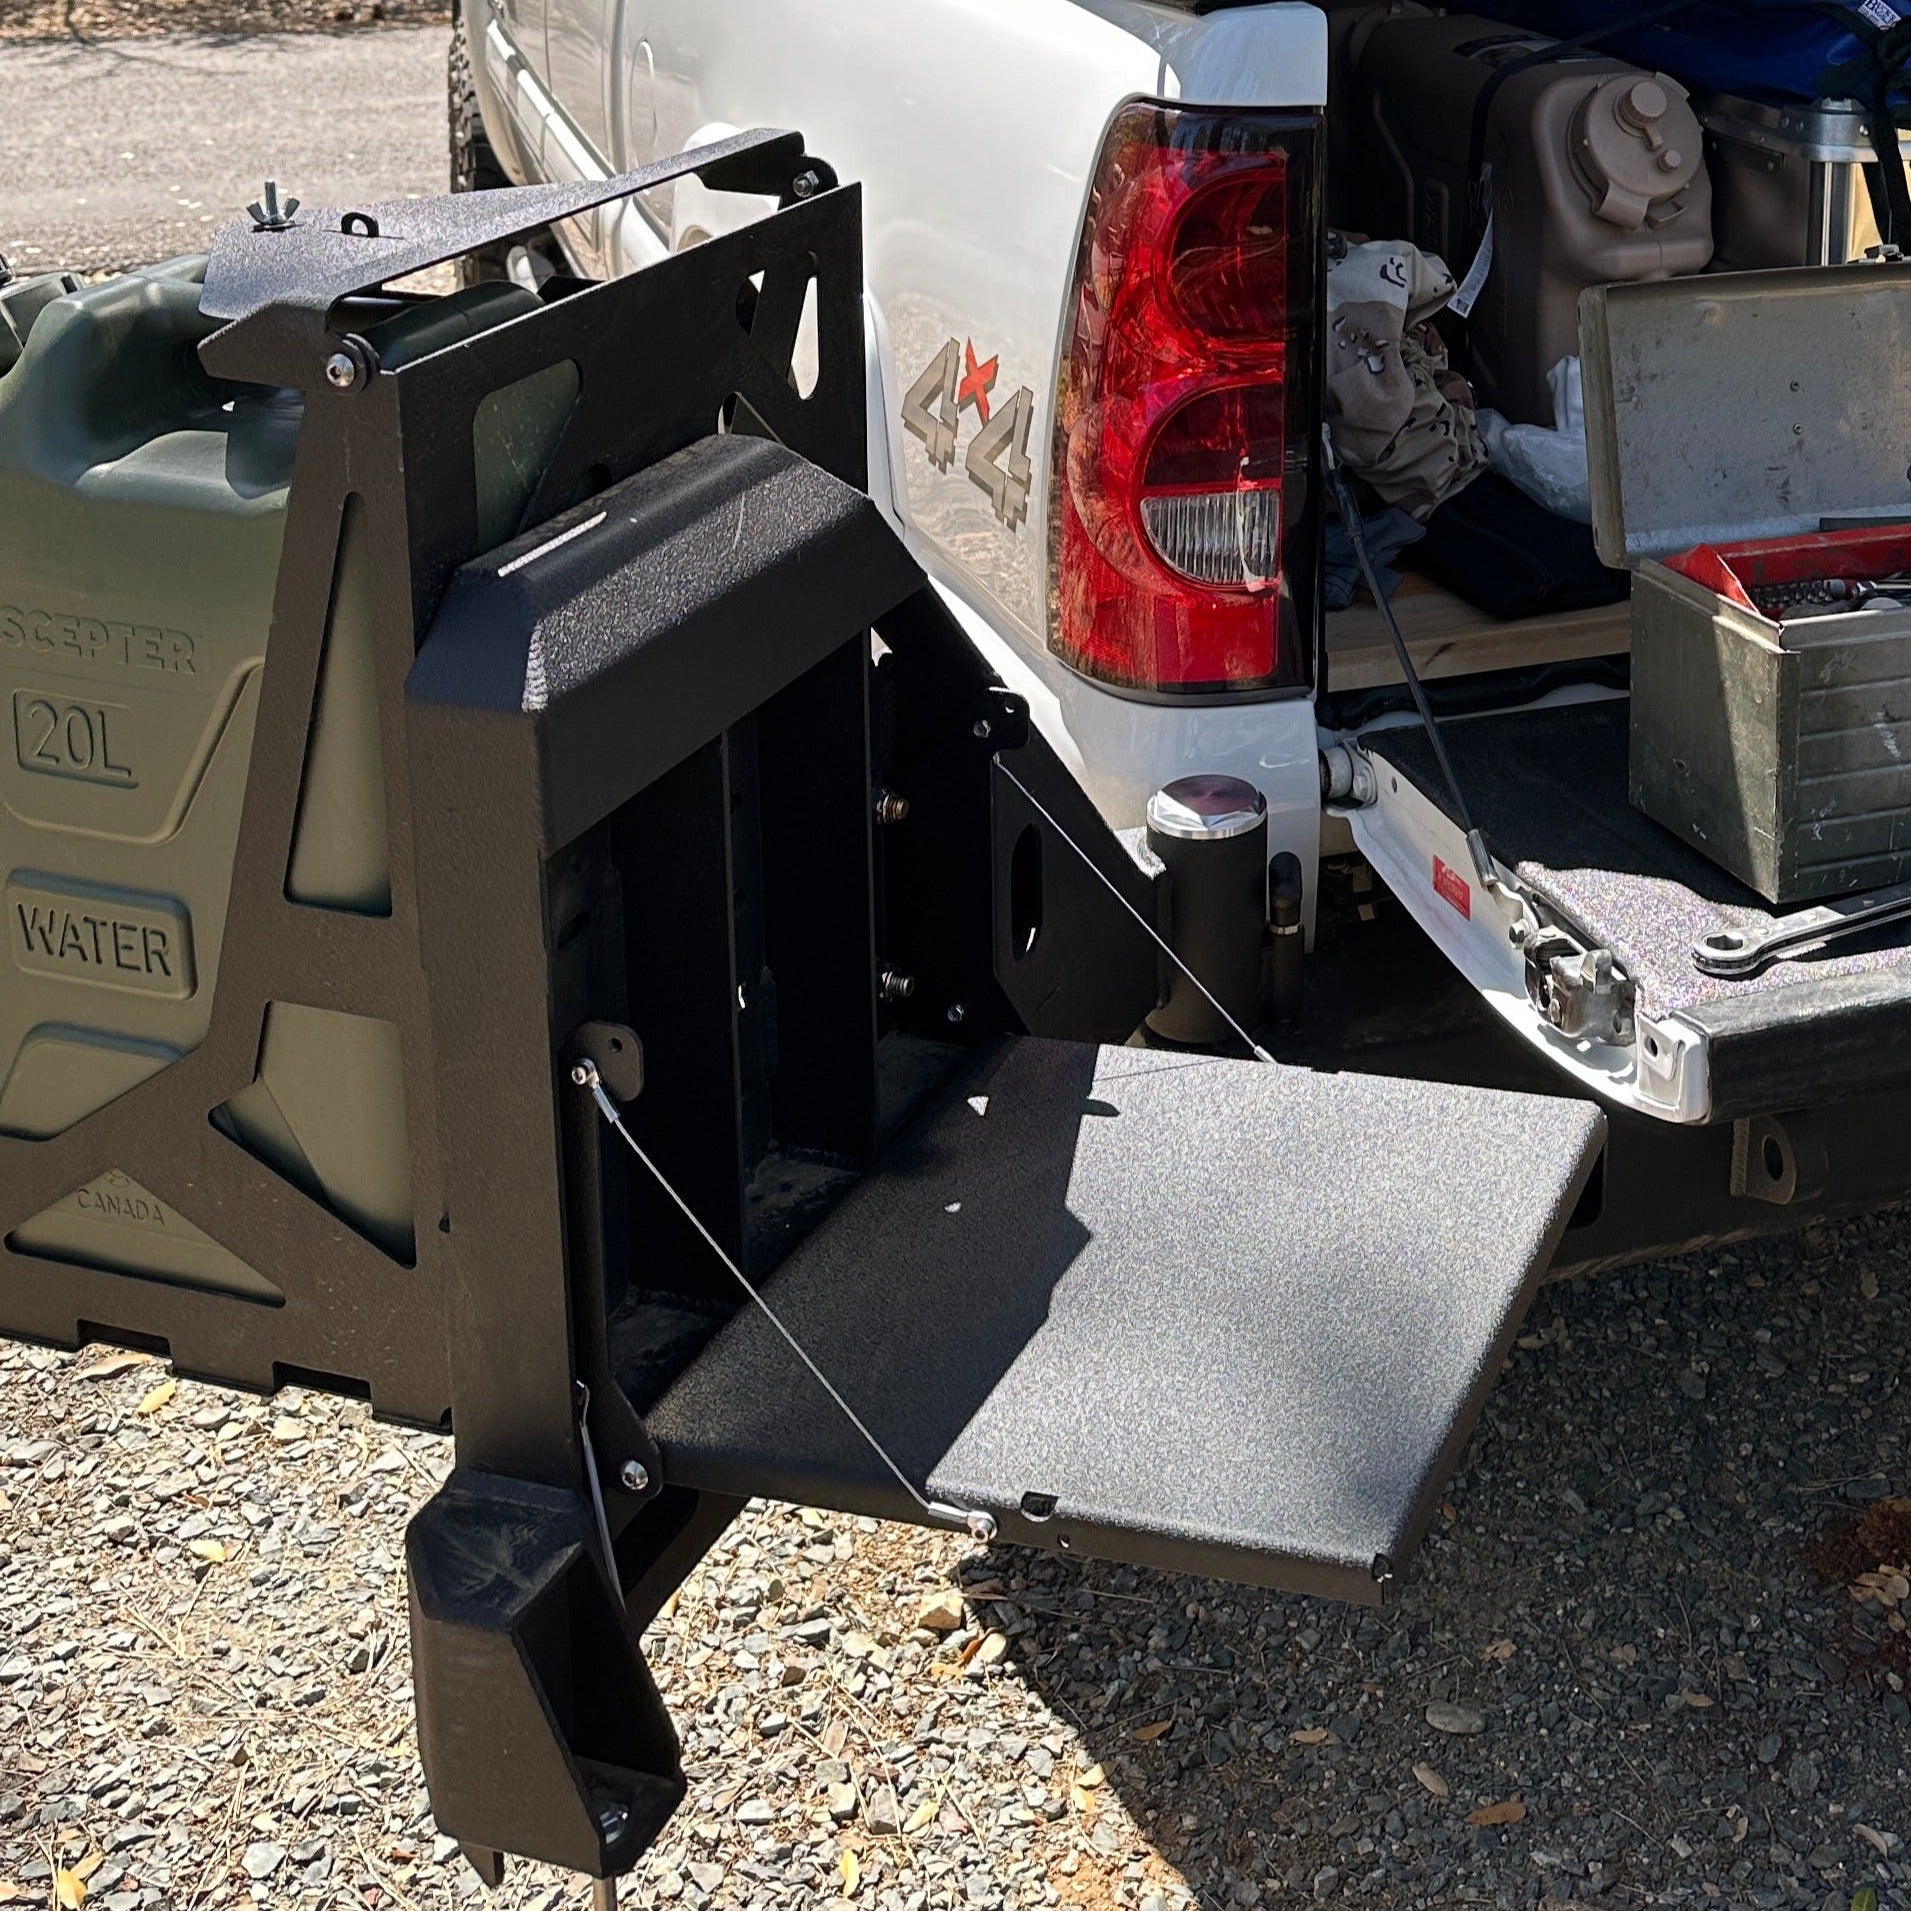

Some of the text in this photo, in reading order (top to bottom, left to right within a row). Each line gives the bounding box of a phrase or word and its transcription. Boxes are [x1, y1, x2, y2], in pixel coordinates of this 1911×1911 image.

[0, 605, 196, 675] SCEPTER
[27, 699, 132, 778] 20L
[17, 902, 172, 977] WATER
[76, 1187, 165, 1226] CANADA
